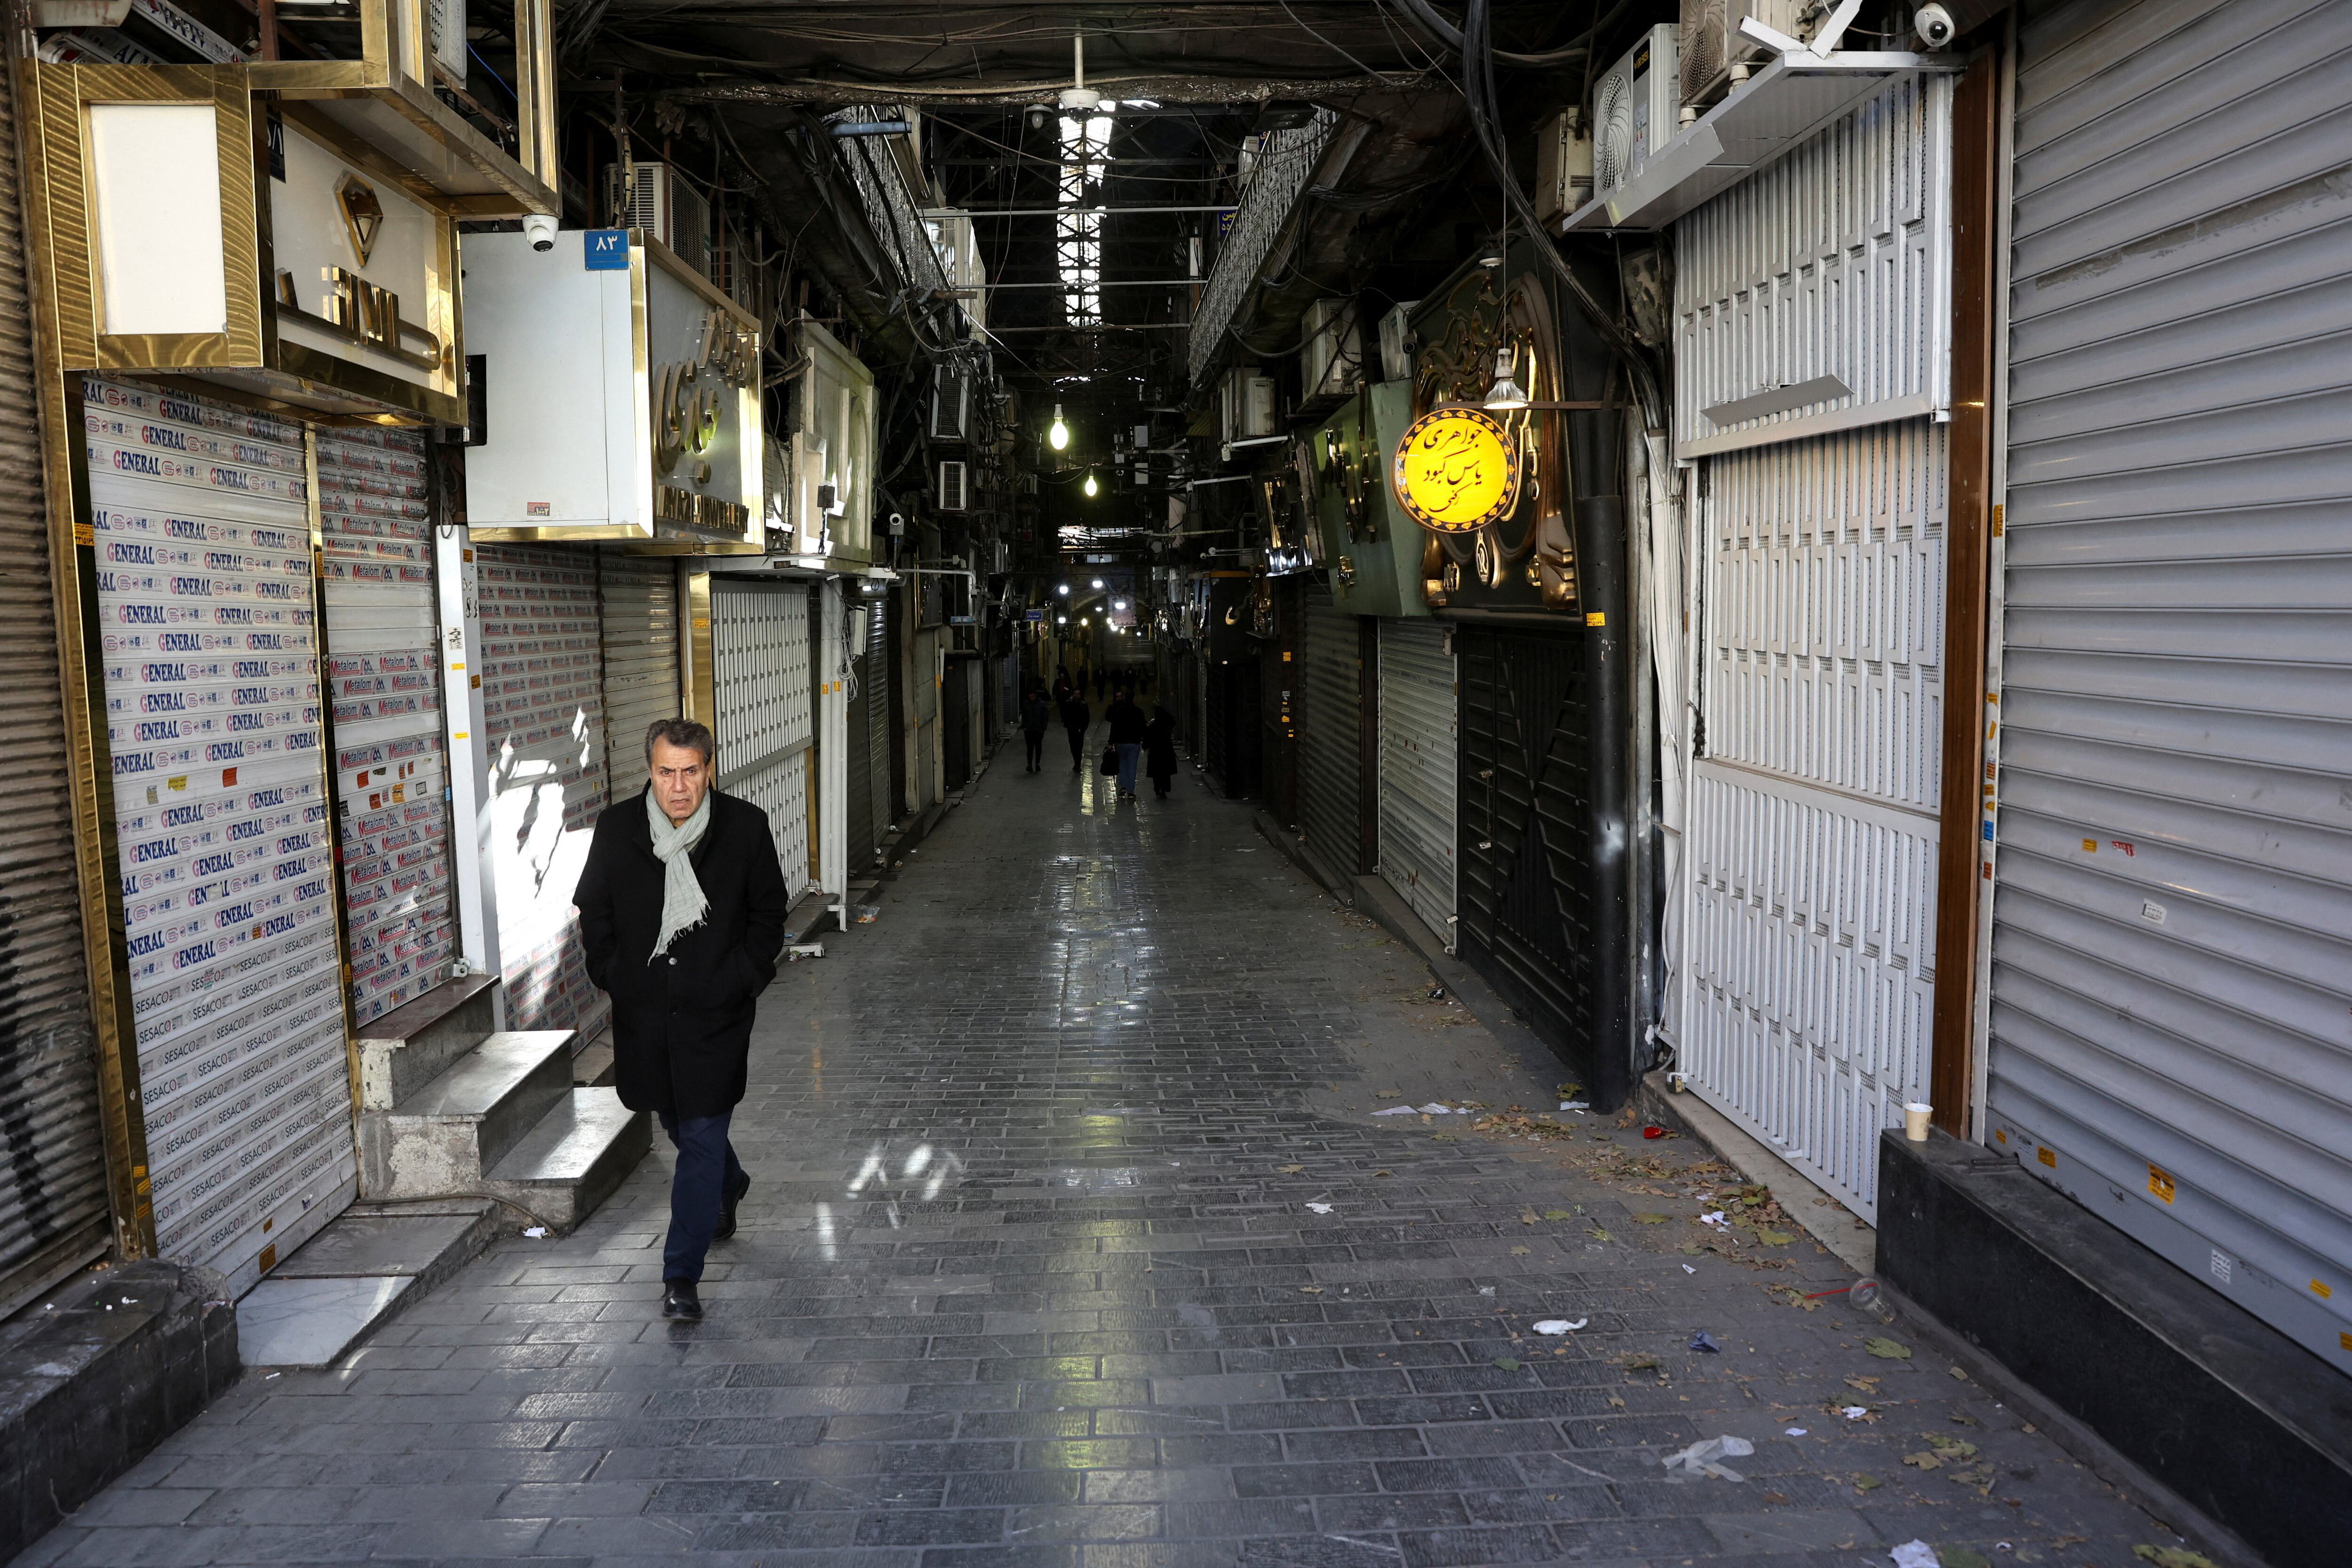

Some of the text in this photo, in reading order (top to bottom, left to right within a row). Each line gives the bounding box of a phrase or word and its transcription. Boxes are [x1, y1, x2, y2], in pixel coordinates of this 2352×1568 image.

[596, 235, 618, 251] ۸۳
[159, 400, 202, 425] GENERAL
[142, 426, 186, 451] GENERAL
[247, 420, 282, 442] GENERAL
[1424, 426, 1482, 451] جواهری
[114, 450, 160, 475] GENERAL
[233, 444, 268, 466] GENERAL
[1423, 447, 1482, 485] یاس کبود
[210, 467, 248, 489] GENERAL
[164, 519, 207, 540] GENERAL
[251, 530, 286, 549] GENERAL
[107, 542, 154, 565] GENERAL
[204, 552, 243, 571] GENERAL
[171, 577, 211, 596] GENERAL
[256, 583, 290, 599] GENERAL
[119, 604, 166, 624] GENERAL
[215, 607, 253, 626] GENERAL
[158, 634, 201, 651] GENERAL
[247, 634, 282, 650] GENERAL
[141, 663, 186, 682] GENERAL
[233, 661, 268, 678] GENERAL
[140, 692, 185, 713] GENERAL
[232, 687, 268, 706] GENERAL
[134, 720, 180, 742] GENERAL
[226, 712, 263, 731] GENERAL
[205, 741, 244, 762] GENERAL
[285, 733, 317, 750] GENERAL
[248, 788, 284, 810] GENERAL
[161, 804, 204, 828] GENERAL
[226, 819, 264, 842] GENERAL
[130, 838, 178, 863] GENERAL
[277, 833, 310, 854] GENERAL
[192, 852, 234, 877] GENERAL
[273, 858, 306, 881] GENERAL
[294, 877, 326, 903] GENERAL
[215, 902, 253, 929] GENERAL
[261, 913, 295, 938] GENERAL
[172, 941, 216, 970] GENERAL
[285, 936, 309, 953] SESACO
[240, 953, 267, 971] SESACO
[286, 961, 309, 979] SESACO
[191, 971, 220, 991] SESO
[242, 979, 268, 998] SESACO
[305, 980, 328, 997] SESACO
[135, 991, 168, 1014] SESACO
[193, 998, 221, 1019] SESACO
[263, 998, 288, 1017] SESACO
[216, 1018, 244, 1040] SESACO
[290, 1010, 313, 1029] SESACO
[140, 1020, 171, 1043] SESACO
[246, 1031, 272, 1052] SESACO
[164, 1041, 195, 1064] SESACO
[287, 1037, 310, 1057] SESACO
[199, 1054, 227, 1076] SESACO
[243, 1060, 270, 1081] SESACO
[306, 1052, 329, 1072] SESACO
[144, 1080, 177, 1104] SESACO
[194, 1085, 223, 1108] SESACO
[265, 1075, 290, 1097] SESACO
[219, 1100, 246, 1123] SESACO
[251, 1109, 276, 1132] SESACO
[286, 1115, 309, 1137] SESACO
[167, 1128, 197, 1155] SESACO
[202, 1136, 231, 1162] SESACO
[240, 1142, 268, 1167] SESACO
[249, 1164, 275, 1189] SESACO
[301, 1156, 324, 1179] SESACO
[192, 1173, 221, 1199] SESACO
[259, 1185, 284, 1211] SESACO
[200, 1196, 229, 1224] SESACO
[211, 1218, 239, 1247] SESACO
